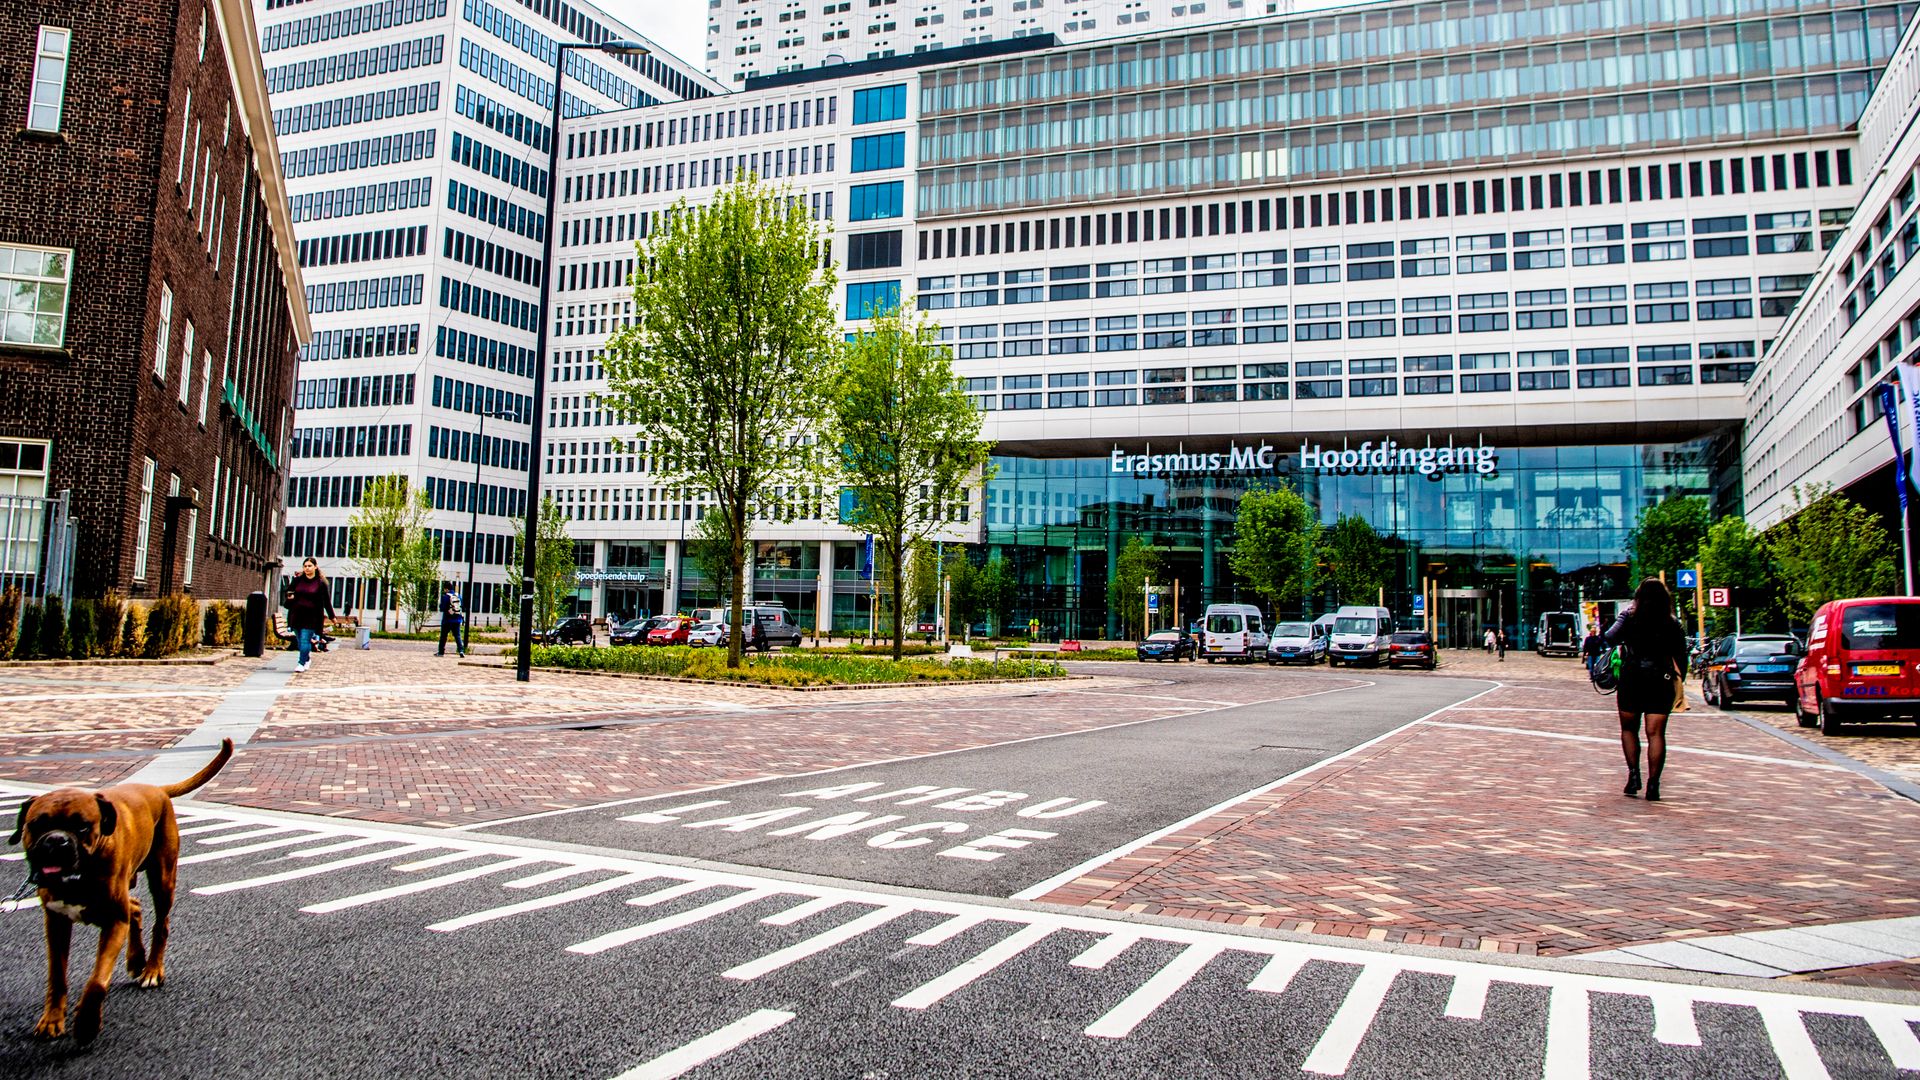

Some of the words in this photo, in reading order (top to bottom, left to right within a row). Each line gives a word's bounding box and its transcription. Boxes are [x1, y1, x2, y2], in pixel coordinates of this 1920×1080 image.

[1111, 449, 1219, 472] Erasmus
[1227, 446, 1274, 470] MC
[1301, 441, 1495, 473] Hoofdingang
[576, 571, 627, 581] Spoedeisende
[627, 572, 645, 583] hulp
[1713, 590, 1724, 603] B
[614, 800, 1059, 861] LANCE
